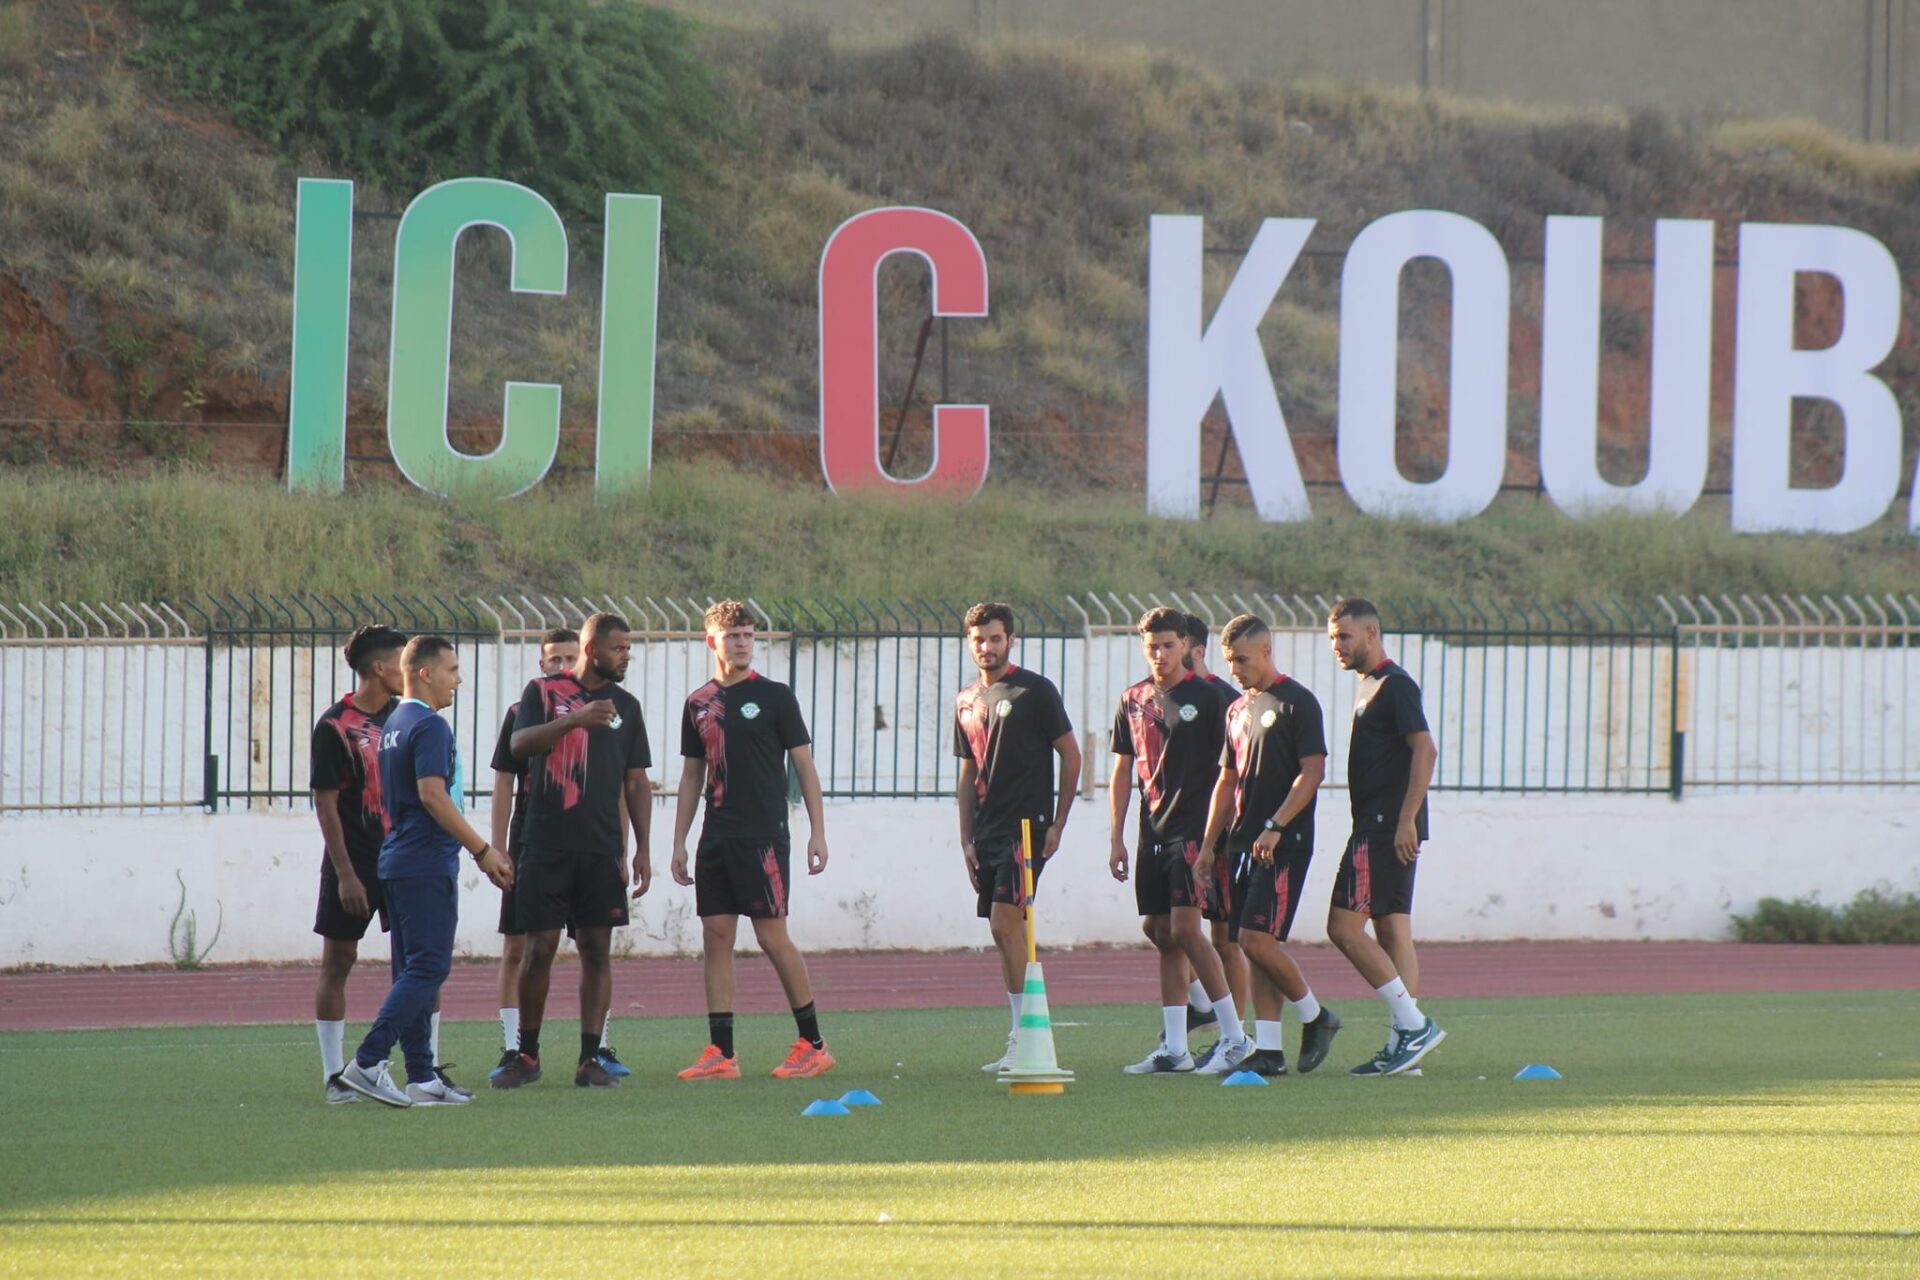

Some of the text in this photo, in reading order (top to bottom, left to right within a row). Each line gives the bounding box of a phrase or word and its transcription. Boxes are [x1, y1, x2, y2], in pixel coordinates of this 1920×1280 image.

[287, 176, 1920, 536] ICI C KOUB
